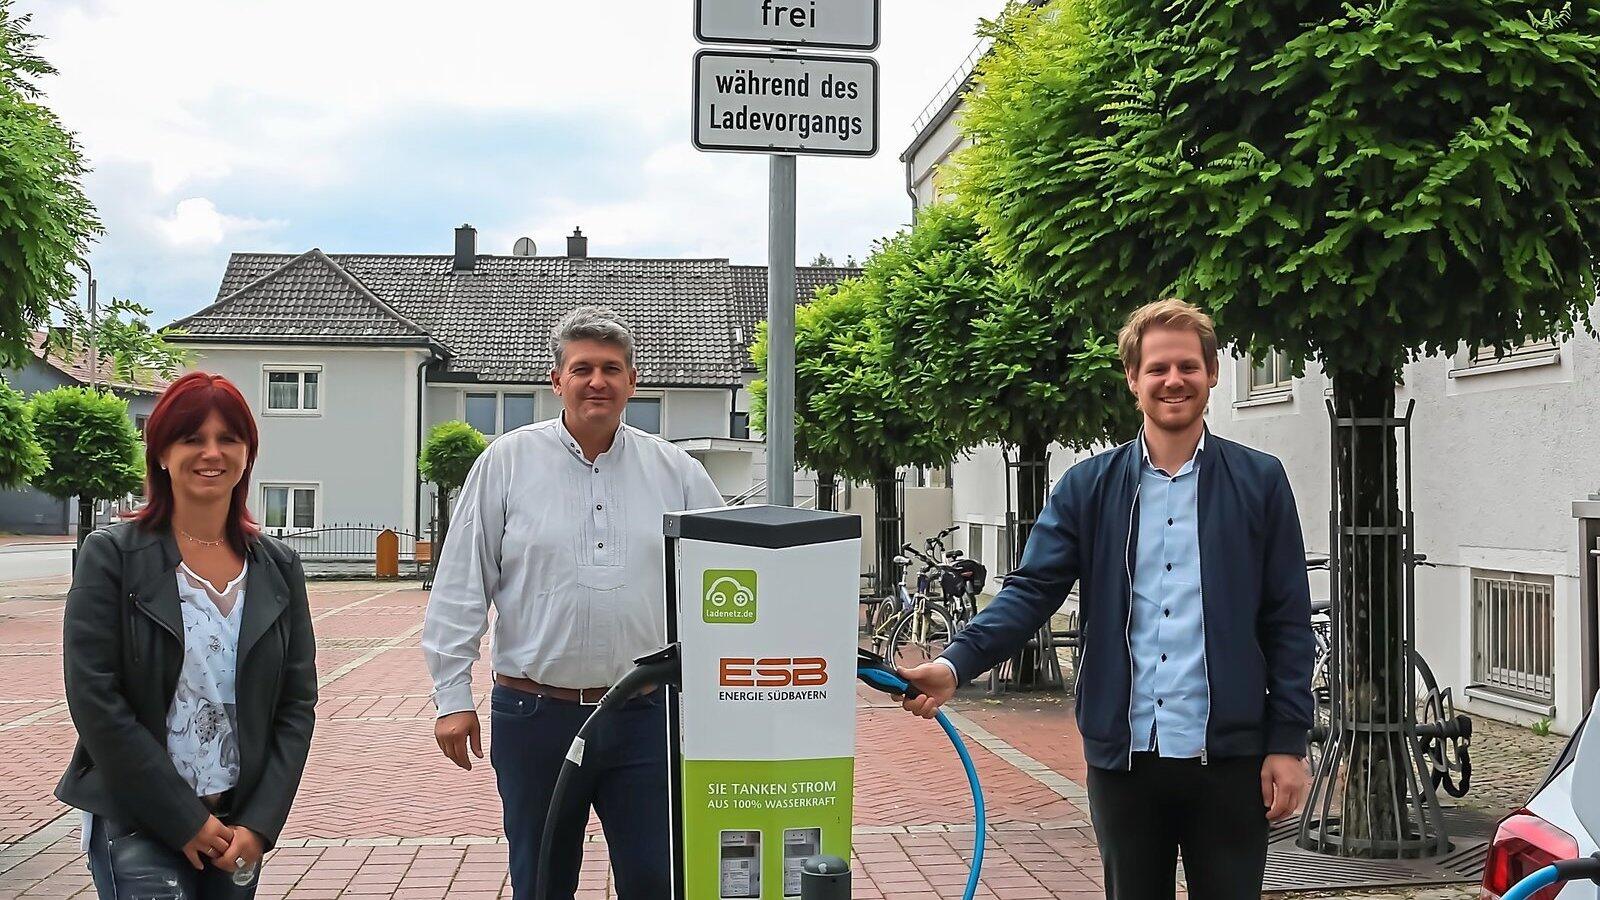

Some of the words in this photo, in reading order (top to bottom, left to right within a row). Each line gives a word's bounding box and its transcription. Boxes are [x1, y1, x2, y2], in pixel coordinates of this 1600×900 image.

[762, 0, 815, 28] frei
[715, 69, 809, 98] während
[821, 73, 858, 100] des
[710, 103, 862, 141] Ladevorgangs
[706, 609, 754, 618] ladenetz.de
[719, 657, 828, 687] ESB
[719, 691, 764, 701] ENERGIE
[767, 689, 827, 701] SÜDBAYERN
[708, 783, 727, 795] SIE
[731, 783, 787, 795] TANKEN
[791, 780, 836, 794] STROM
[707, 799, 729, 809] AUS
[733, 799, 762, 809] 100%
[765, 796, 836, 809] WASSERKRAFT
